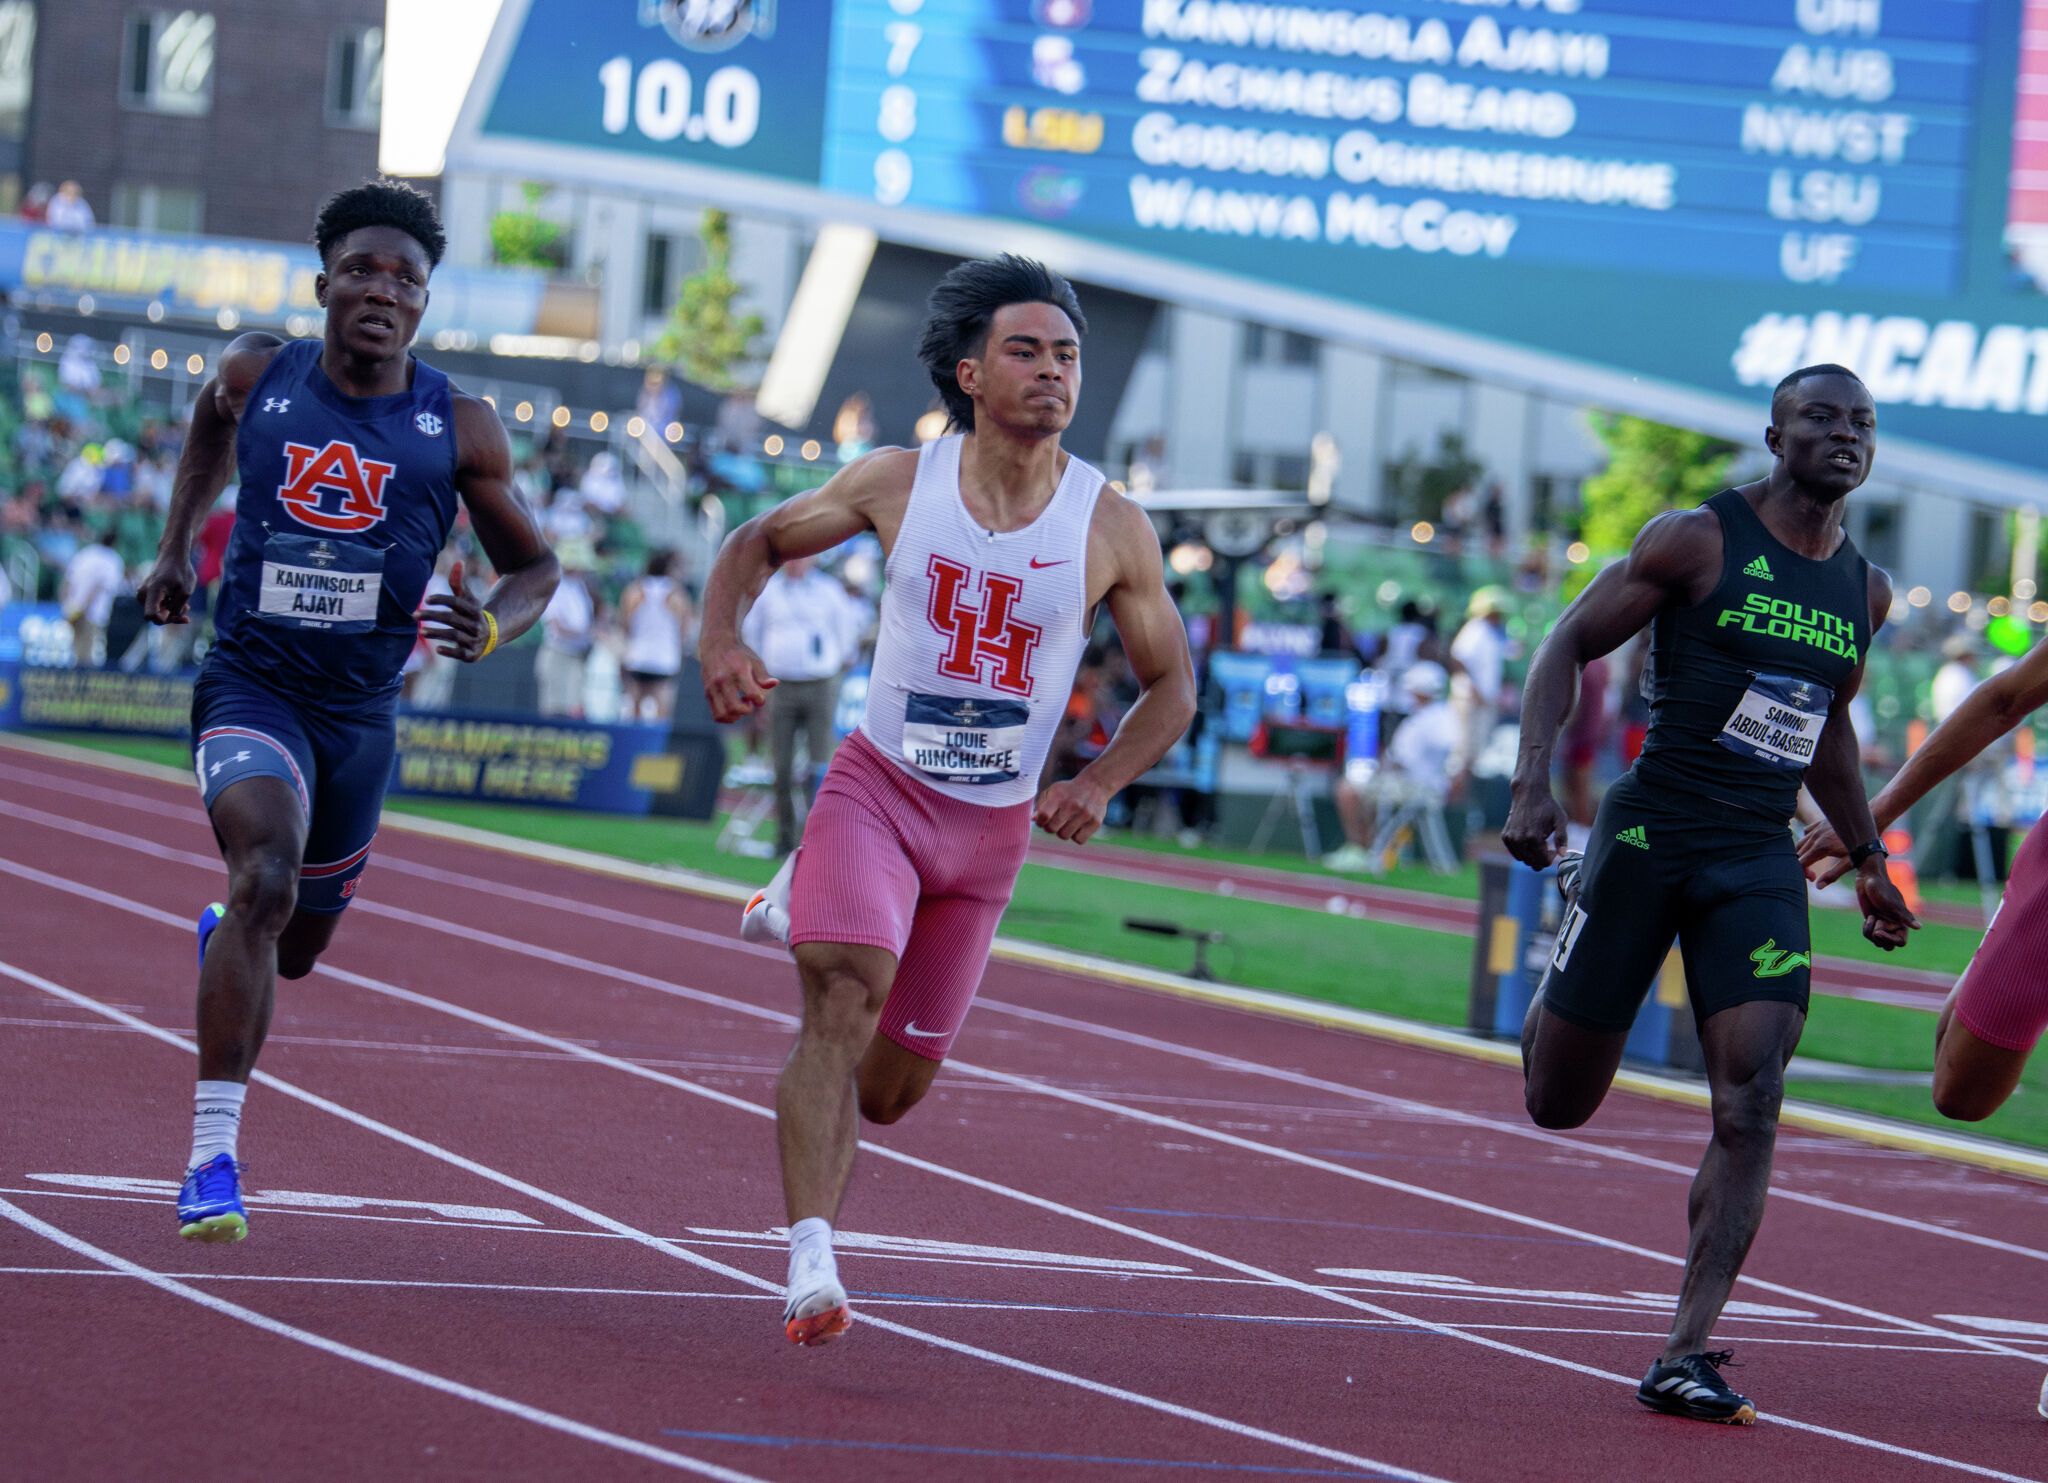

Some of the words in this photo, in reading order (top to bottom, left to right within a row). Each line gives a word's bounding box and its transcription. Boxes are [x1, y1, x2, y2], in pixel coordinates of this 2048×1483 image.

[884, 20, 923, 78] 7
[1770, 43, 1895, 103] AUB
[598, 54, 762, 148] 10.0
[877, 84, 917, 143] 8
[1741, 102, 1915, 166] NWST
[873, 147, 914, 207] 9
[1767, 167, 1882, 226] LSU
[1779, 230, 1860, 286] UF
[415, 411, 444, 436] SEC
[276, 569, 365, 593] KANYINSOLA
[1742, 565, 1775, 582] adidas
[291, 592, 344, 616] AJAYI
[926, 552, 1043, 698] UH
[1742, 592, 1855, 642] SOUTH
[1716, 609, 1858, 666] FLORIDA
[914, 749, 1013, 769] HINCHLIFFE
[945, 731, 988, 749] LOUIE
[1729, 713, 1814, 758] ABDUL-RASHEED
[1615, 833, 1650, 850] adidas
